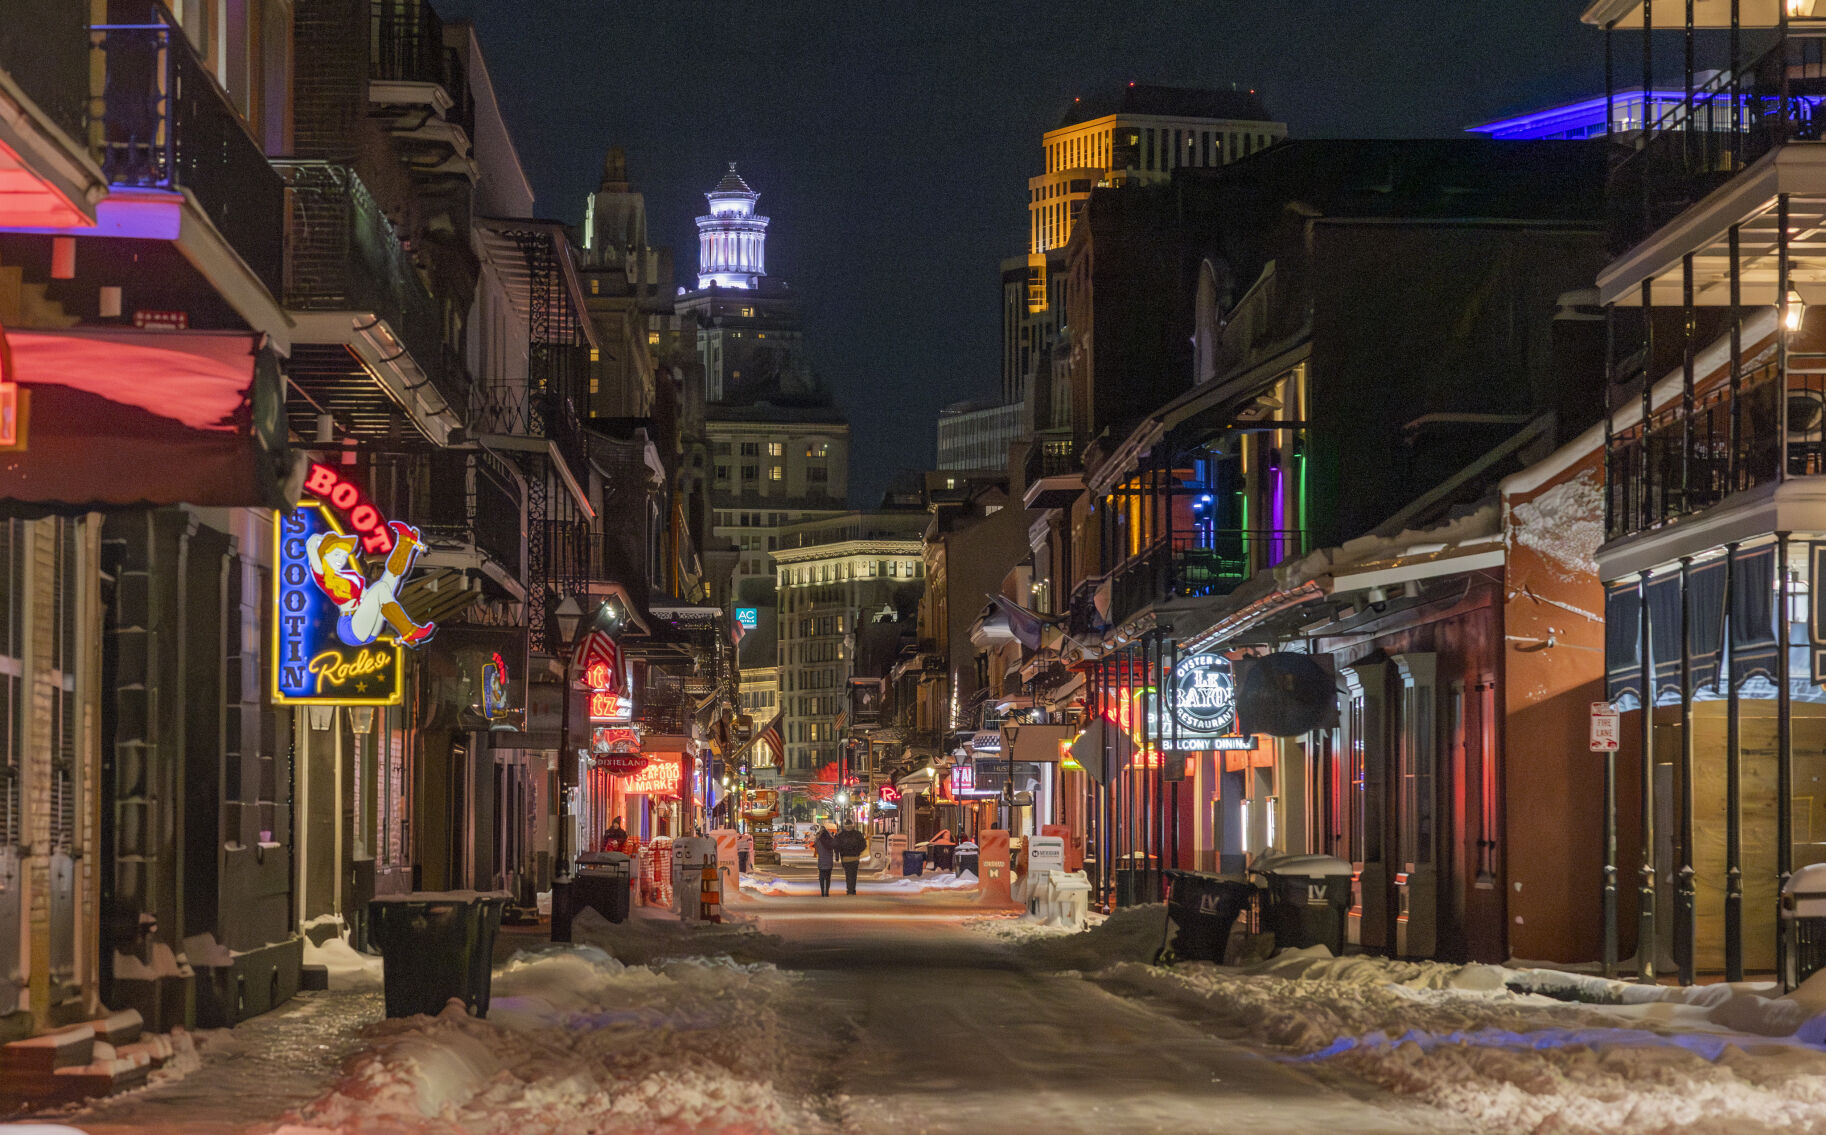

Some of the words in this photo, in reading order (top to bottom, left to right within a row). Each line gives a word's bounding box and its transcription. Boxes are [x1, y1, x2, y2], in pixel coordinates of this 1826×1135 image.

[305, 464, 392, 554] BOOT
[283, 510, 308, 688] SCOOTIN
[739, 611, 755, 620] AC
[309, 649, 391, 694] Rodeo
[1177, 656, 1213, 678] OYSTER
[1194, 670, 1219, 688] LE
[1177, 706, 1234, 729] RESTAURANT
[1162, 739, 1211, 750] BALCONY
[597, 758, 648, 767] DIXIELAND
[635, 768, 680, 782] SEAFOOD
[635, 778, 679, 792] MARKET
[1307, 884, 1328, 900] IV
